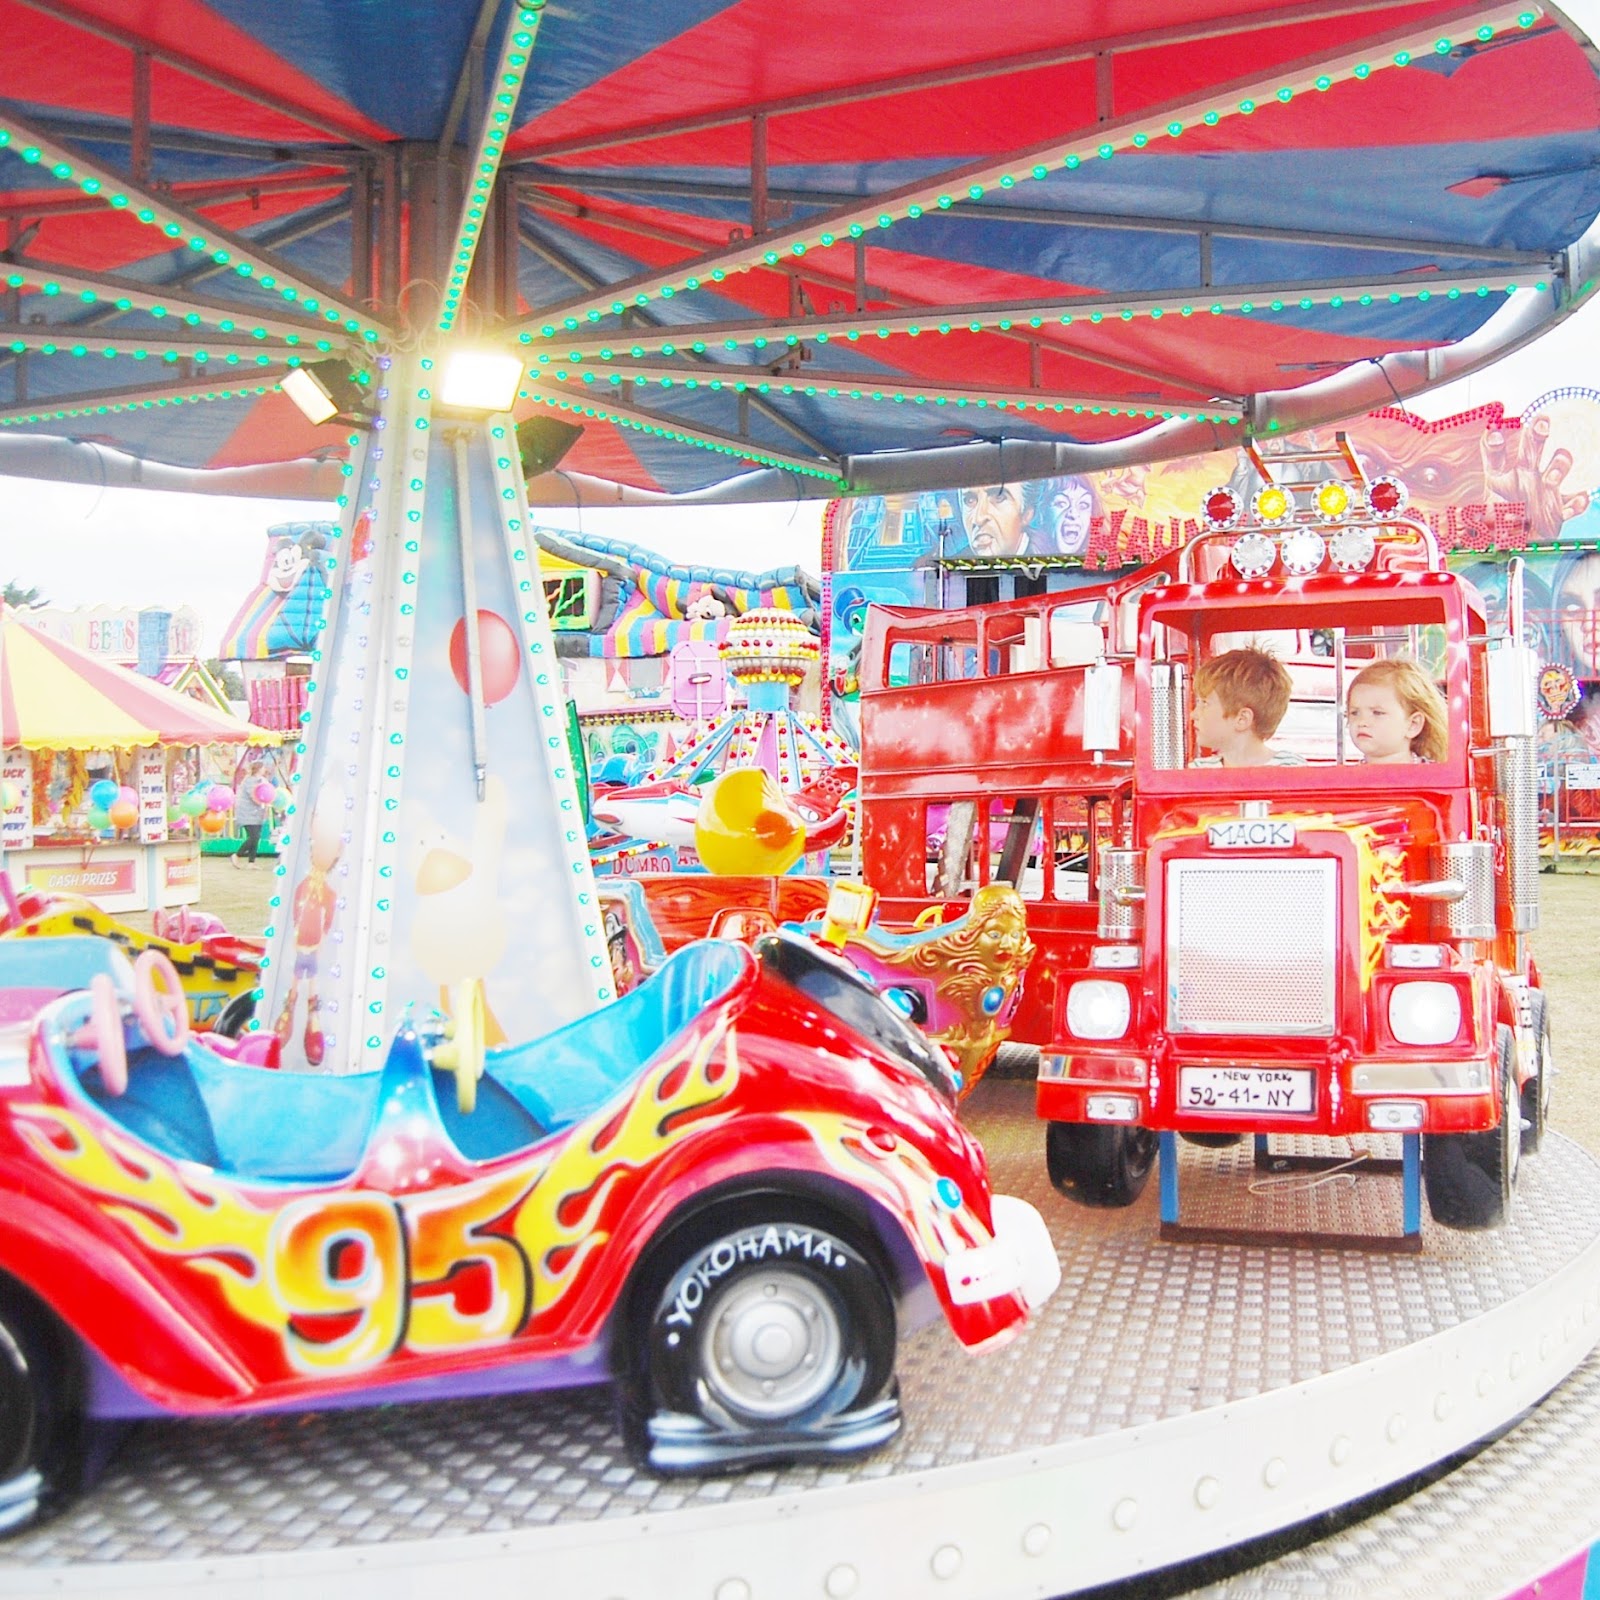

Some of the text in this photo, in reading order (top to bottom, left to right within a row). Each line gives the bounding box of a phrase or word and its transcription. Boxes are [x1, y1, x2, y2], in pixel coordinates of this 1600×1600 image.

[1403, 503, 1528, 553] USE
[63, 618, 136, 651] EETS
[3, 768, 26, 778] UCK
[143, 765, 162, 775] DUCK
[3, 822, 26, 831] VERY
[1209, 824, 1290, 845] MACK
[611, 855, 671, 875] DUMBO
[49, 871, 118, 887] CASH PRIZES
[1223, 1071, 1250, 1081] NEW
[268, 1150, 555, 1376] 95
[666, 1226, 832, 1326] YOKOHAMA
